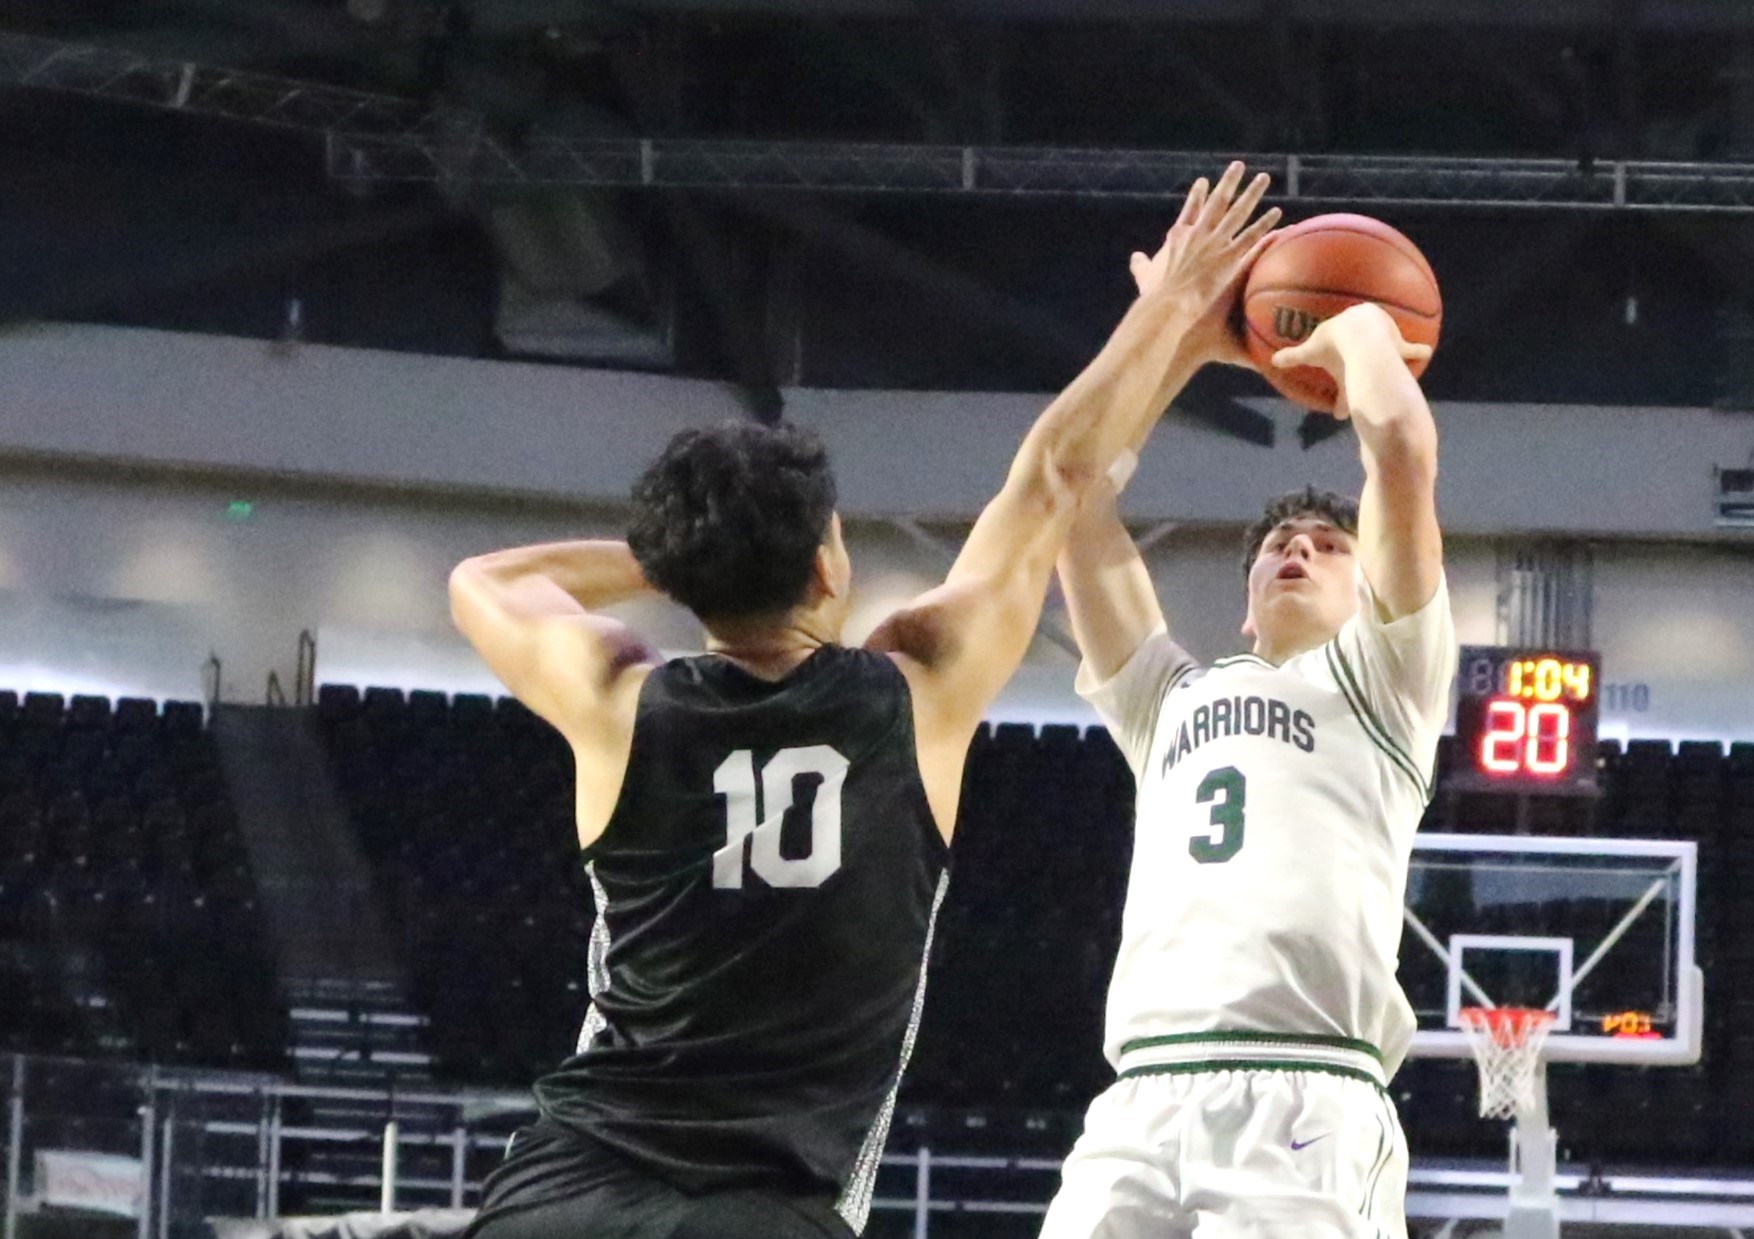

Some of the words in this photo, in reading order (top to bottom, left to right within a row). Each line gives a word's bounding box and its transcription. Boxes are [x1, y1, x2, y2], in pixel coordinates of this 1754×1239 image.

[1509, 658, 1591, 701] 1:04
[1161, 695, 1315, 781] WARRIORS
[1482, 701, 1570, 773] 20
[712, 744, 851, 889] 10
[1188, 765, 1246, 864] 3
